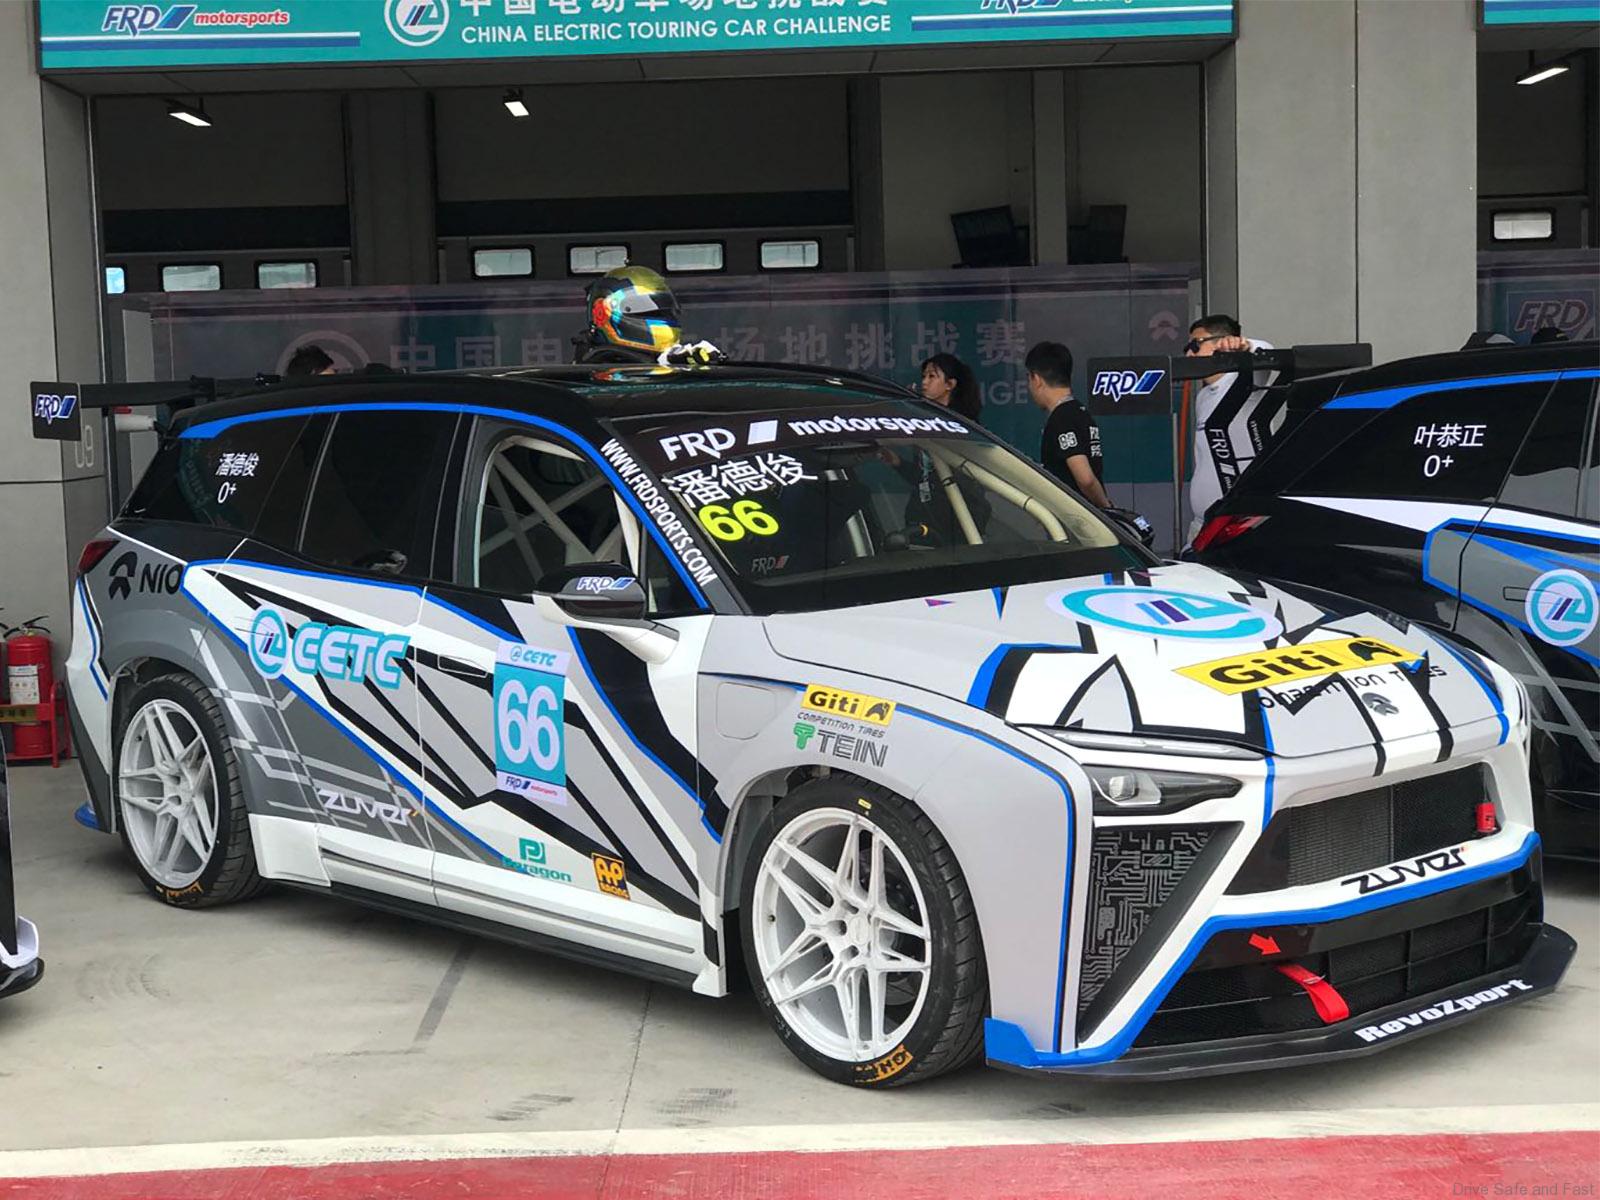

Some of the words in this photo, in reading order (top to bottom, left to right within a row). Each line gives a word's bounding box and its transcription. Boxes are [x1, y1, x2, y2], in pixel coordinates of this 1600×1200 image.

[102, 5, 162, 37] FRD
[194, 10, 290, 27] motorsports
[461, 25, 528, 44] CHINA
[534, 23, 622, 42] ELECTRIC
[628, 20, 718, 39] TOURING
[724, 19, 767, 37] CAR
[773, 15, 891, 35] CHALLENGE
[1092, 370, 1138, 402] FRD
[34, 394, 61, 425] FRD
[659, 428, 736, 461] FRD
[787, 415, 969, 435] motorsports
[1209, 429, 1230, 459] FRD
[1413, 423, 1487, 448] 叶恭正
[661, 453, 818, 508] 潘德俊
[600, 438, 718, 587] WWW.FRDSPORTS.COM
[698, 500, 779, 541] 66
[139, 564, 182, 595] NIO
[751, 557, 776, 574] FRD
[577, 576, 613, 593] FRD
[293, 623, 410, 690] CETC
[523, 650, 557, 666] CETC
[1210, 650, 1343, 685] Giti
[809, 690, 859, 714] Giti
[498, 680, 560, 771] 66
[817, 729, 888, 767] TEIN
